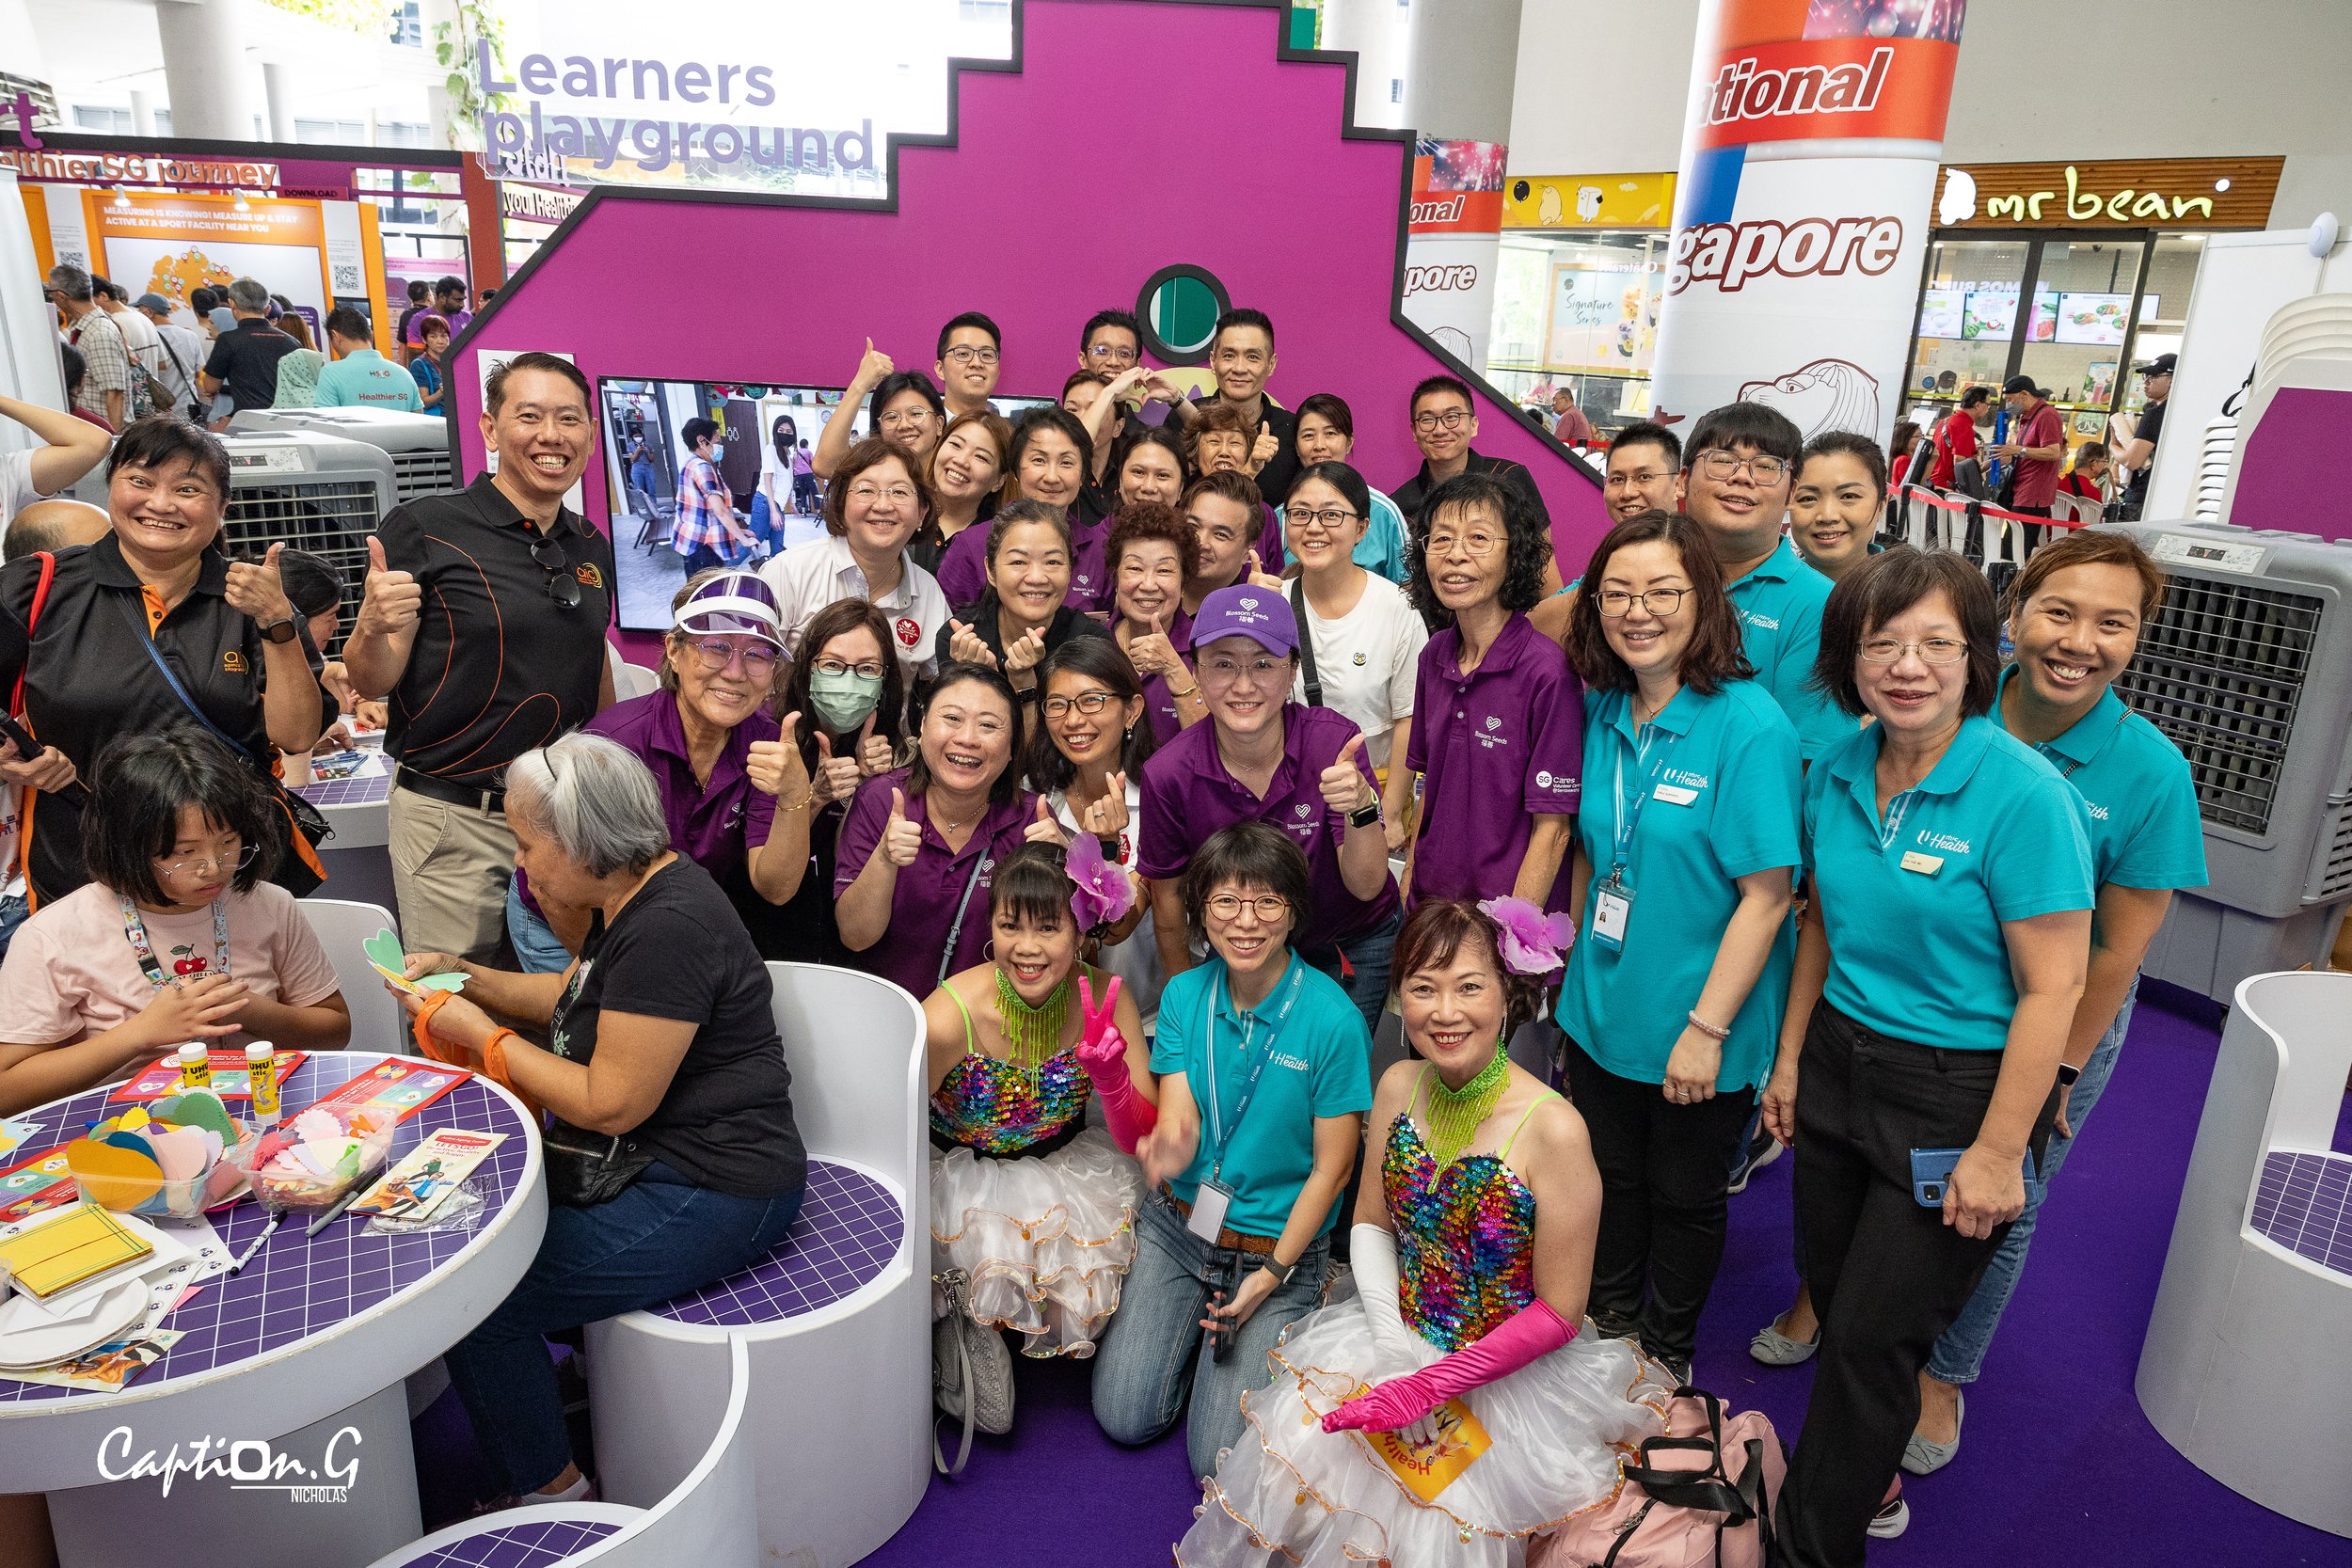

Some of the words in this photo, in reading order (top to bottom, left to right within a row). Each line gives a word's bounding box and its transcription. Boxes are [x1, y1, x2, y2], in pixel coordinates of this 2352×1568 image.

[477, 38, 776, 107] Learners
[484, 100, 874, 173] playground
[154, 152, 278, 190] journey
[284, 189, 338, 198] DOWNLOAD
[1987, 189, 2055, 223] mr
[2064, 165, 2214, 223] bean
[103, 206, 155, 216] MEASURING
[165, 210, 212, 219] KNOWING!
[213, 213, 253, 221] MEASURE
[275, 215, 298, 224] STAY
[1409, 195, 1466, 224] onal
[105, 217, 137, 226] ACTIVE
[159, 220, 187, 229] SPORT
[188, 221, 226, 230] FACILITY
[1667, 215, 1903, 296] gapore
[1403, 264, 1477, 297] pore
[1565, 293, 1614, 315] Signature
[1251, 611, 1269, 621] Seeds
[1747, 613, 1779, 630] Health
[1474, 730, 1491, 740] Blossom
[1491, 736, 1507, 745] Seeds
[1553, 776, 1576, 784] Cares
[1677, 770, 1708, 788] Health
[1930, 833, 1970, 854] Health
[190, 1064, 208, 1074] UHU
[248, 1061, 270, 1070] UHU
[1275, 1052, 1309, 1071] Health
[195, 1071, 208, 1080] stic
[1381, 1431, 1430, 1475] Health
